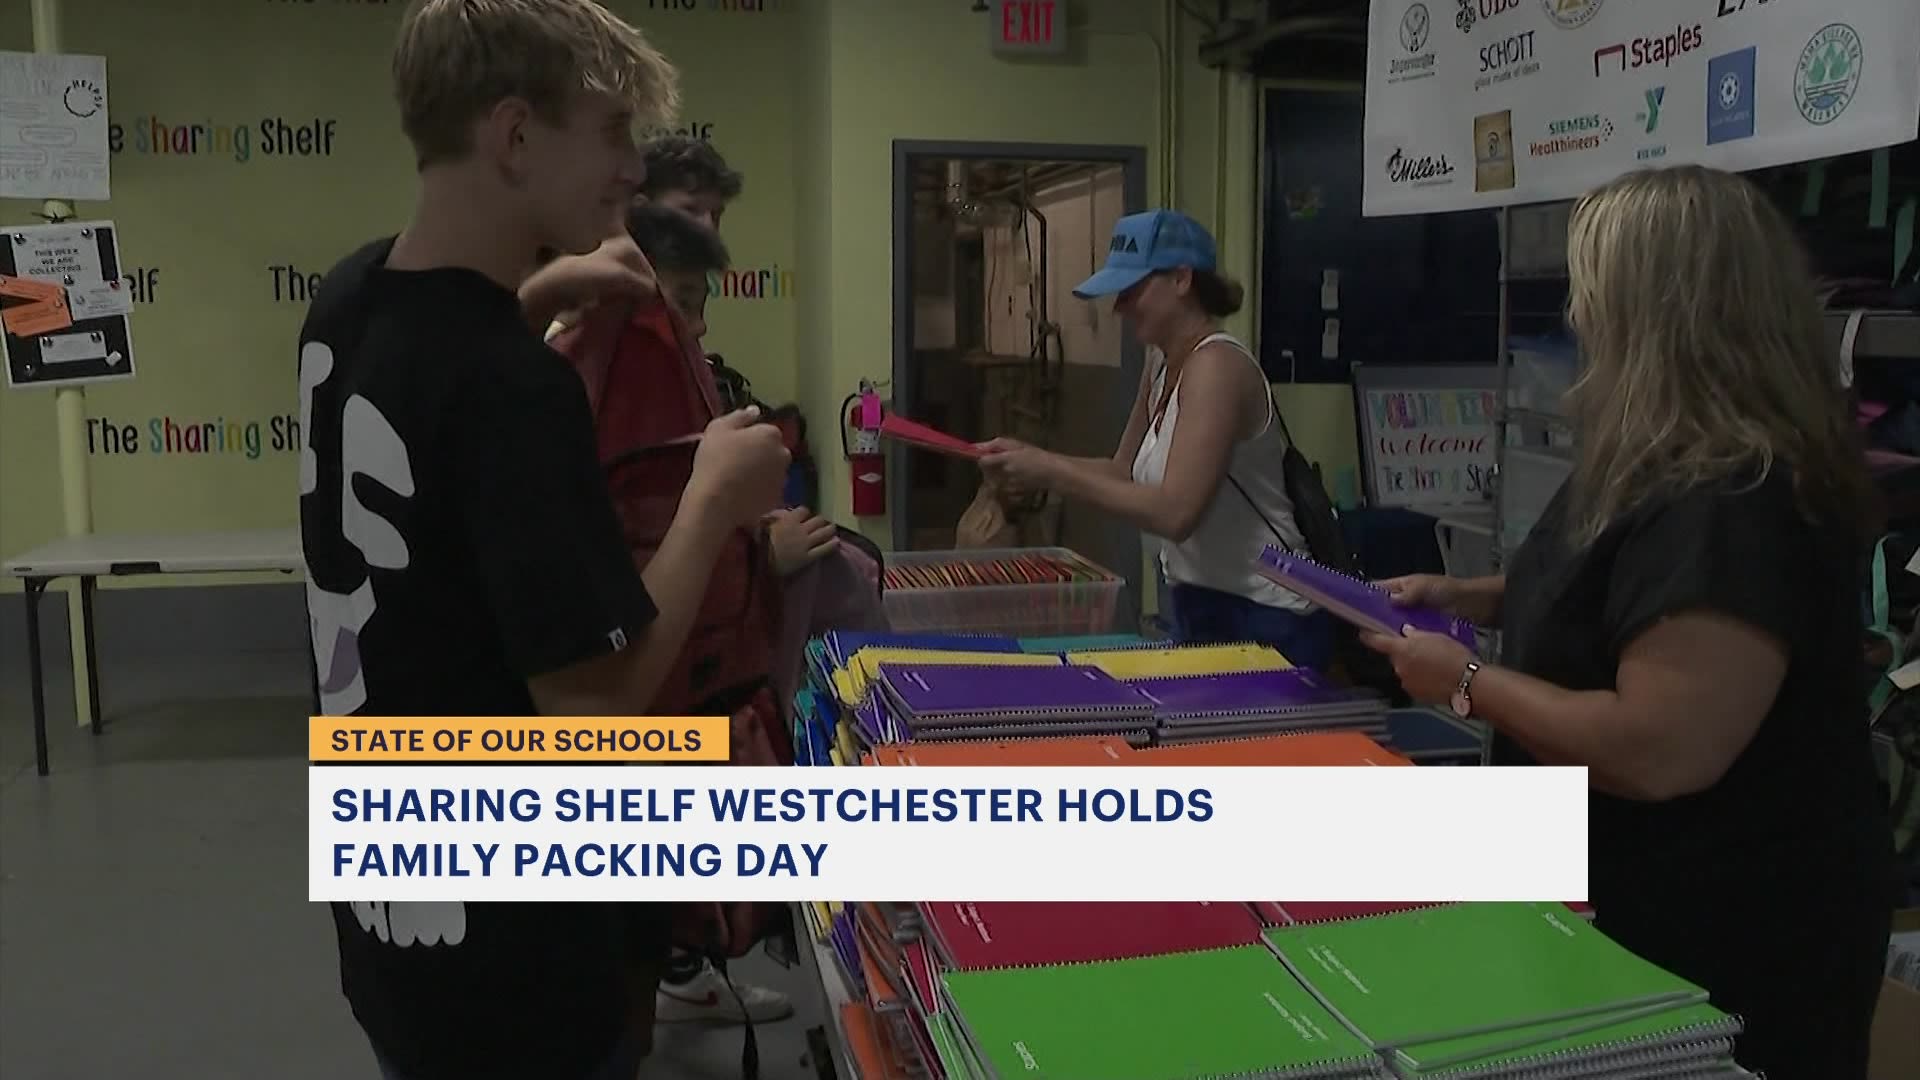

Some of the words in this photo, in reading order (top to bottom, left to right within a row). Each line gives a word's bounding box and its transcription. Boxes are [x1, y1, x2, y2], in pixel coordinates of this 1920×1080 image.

[1003, 0, 1056, 45] EXIT
[1480, 30, 1535, 72] SCHOTT
[1631, 24, 1702, 68] Staples
[136, 115, 251, 162] Sharing
[260, 118, 337, 156] Shelf
[1529, 134, 1600, 157] Healthineers
[1550, 114, 1600, 135] SIEMENS
[269, 265, 322, 300] The
[87, 418, 138, 453] The
[149, 416, 261, 460] Sharing
